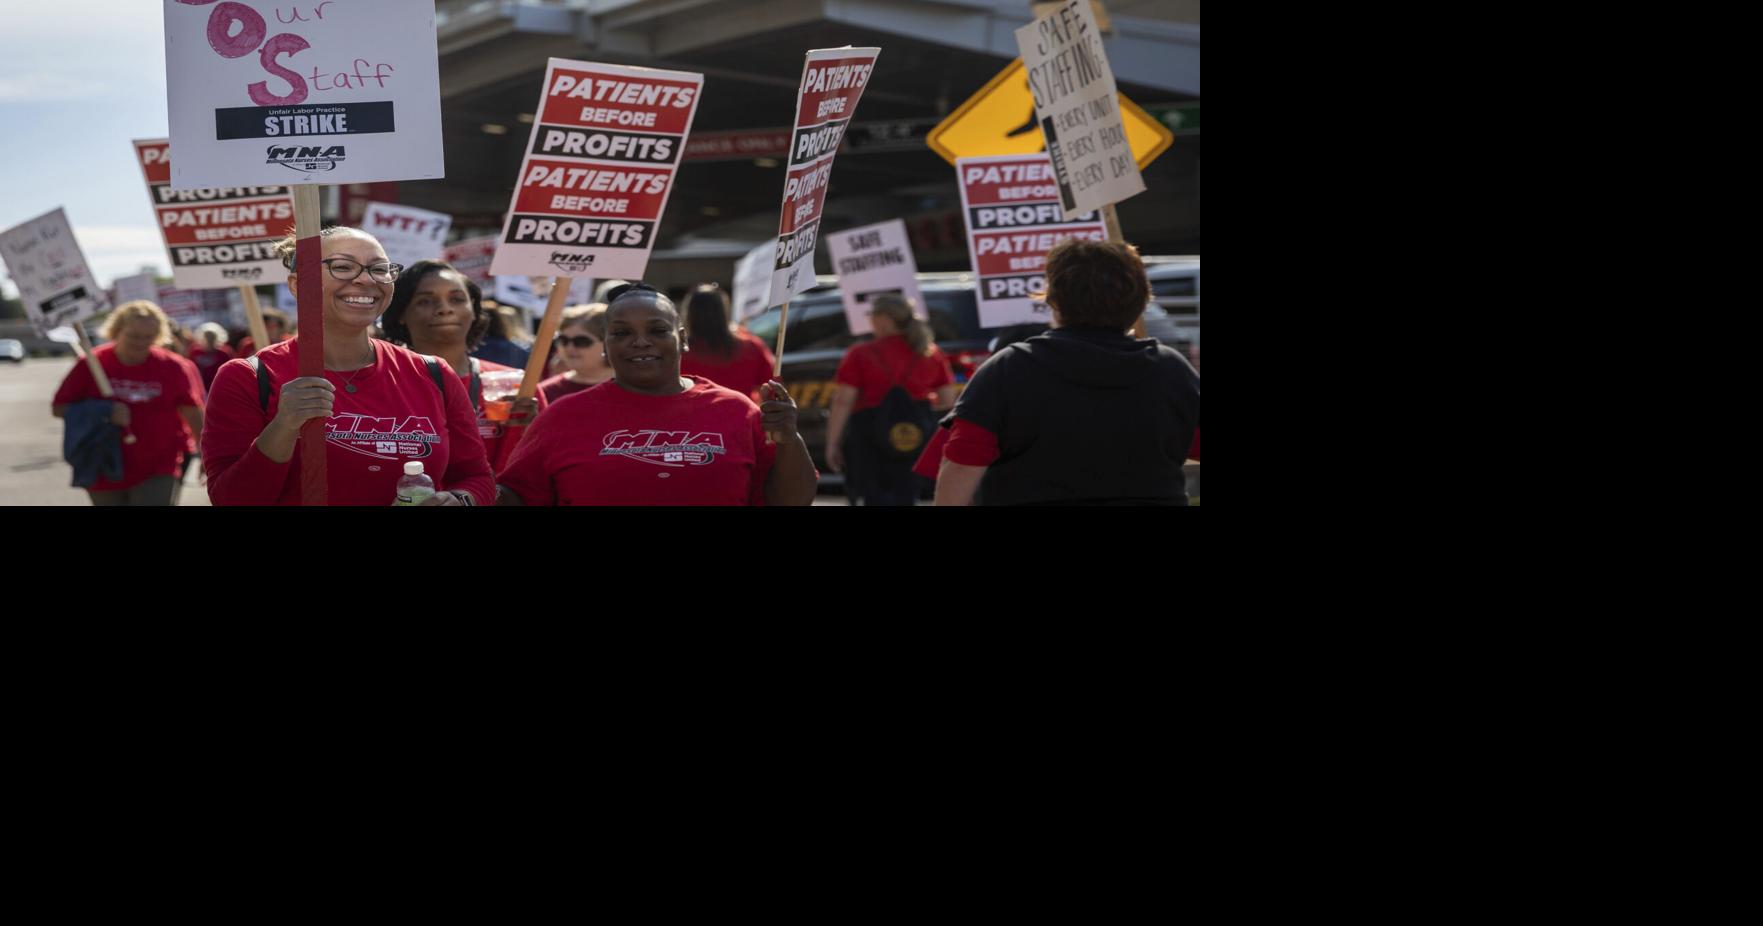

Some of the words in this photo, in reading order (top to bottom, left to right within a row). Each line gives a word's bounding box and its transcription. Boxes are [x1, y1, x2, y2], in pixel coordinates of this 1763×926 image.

[1037, 1, 1087, 56] SAFE
[247, 33, 394, 106] Staff
[804, 63, 872, 94] PATIENTS
[550, 75, 695, 108] PATIENTS
[264, 113, 348, 136] STRIKE
[579, 106, 657, 127] BEFORE
[542, 130, 673, 160] PROFITS
[523, 165, 669, 194] PATIENTS
[966, 162, 1055, 185] PATIEN
[550, 195, 629, 213] BEFORE
[998, 185, 1058, 200] BEFOR
[162, 203, 292, 228] PATIENTS
[373, 210, 444, 241] WTF?
[977, 205, 1093, 226] PROFI
[194, 224, 267, 241] BEFORE
[514, 218, 645, 246] PROFITS
[176, 241, 277, 265] PROFIT
[551, 251, 596, 262] MNA
[839, 247, 905, 275] STAFFING
[1008, 255, 1047, 270] BEF
[605, 430, 724, 449] MNA
